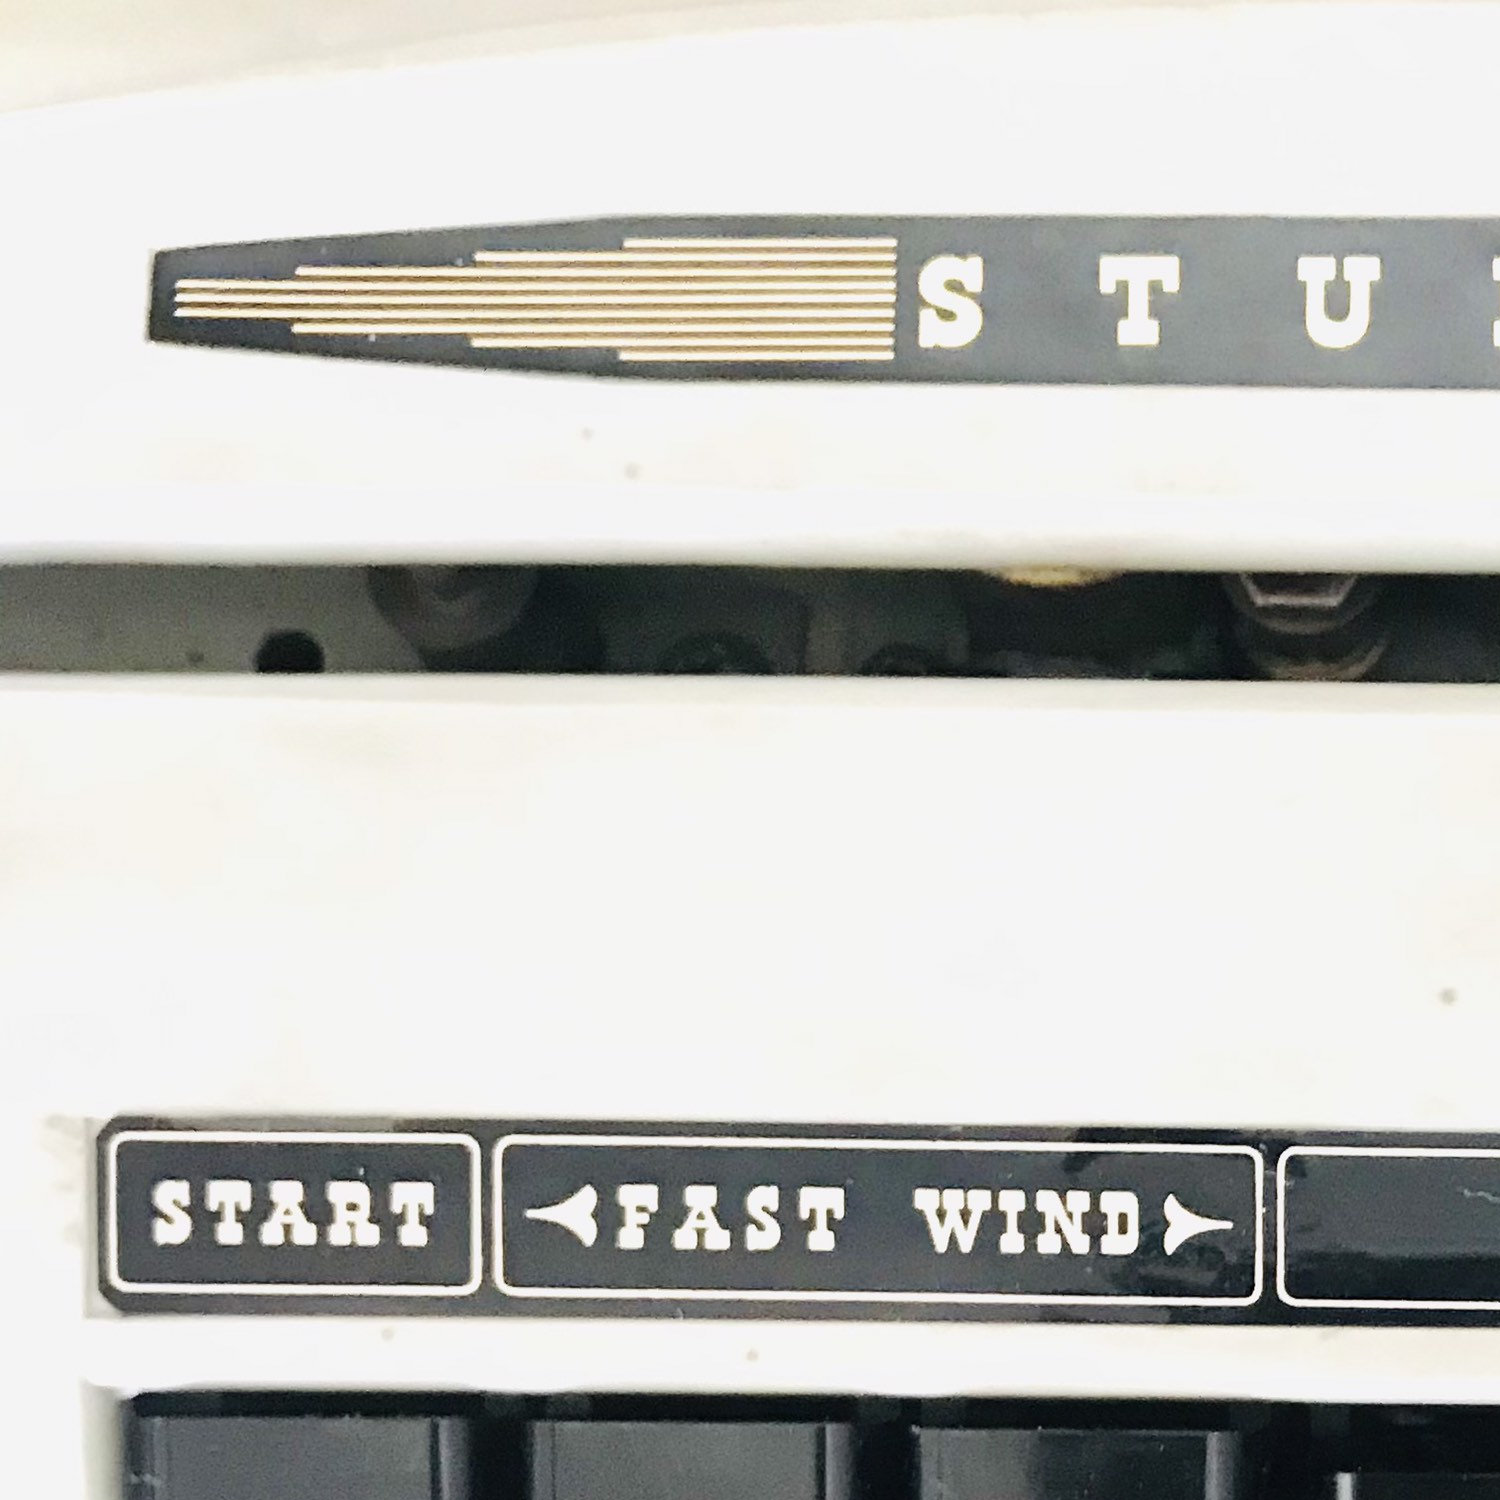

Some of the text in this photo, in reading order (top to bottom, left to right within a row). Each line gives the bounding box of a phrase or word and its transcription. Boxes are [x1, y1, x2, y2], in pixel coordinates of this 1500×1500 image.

[151, 1178, 437, 1249] START
[614, 1182, 1142, 1258] FAST WIND
